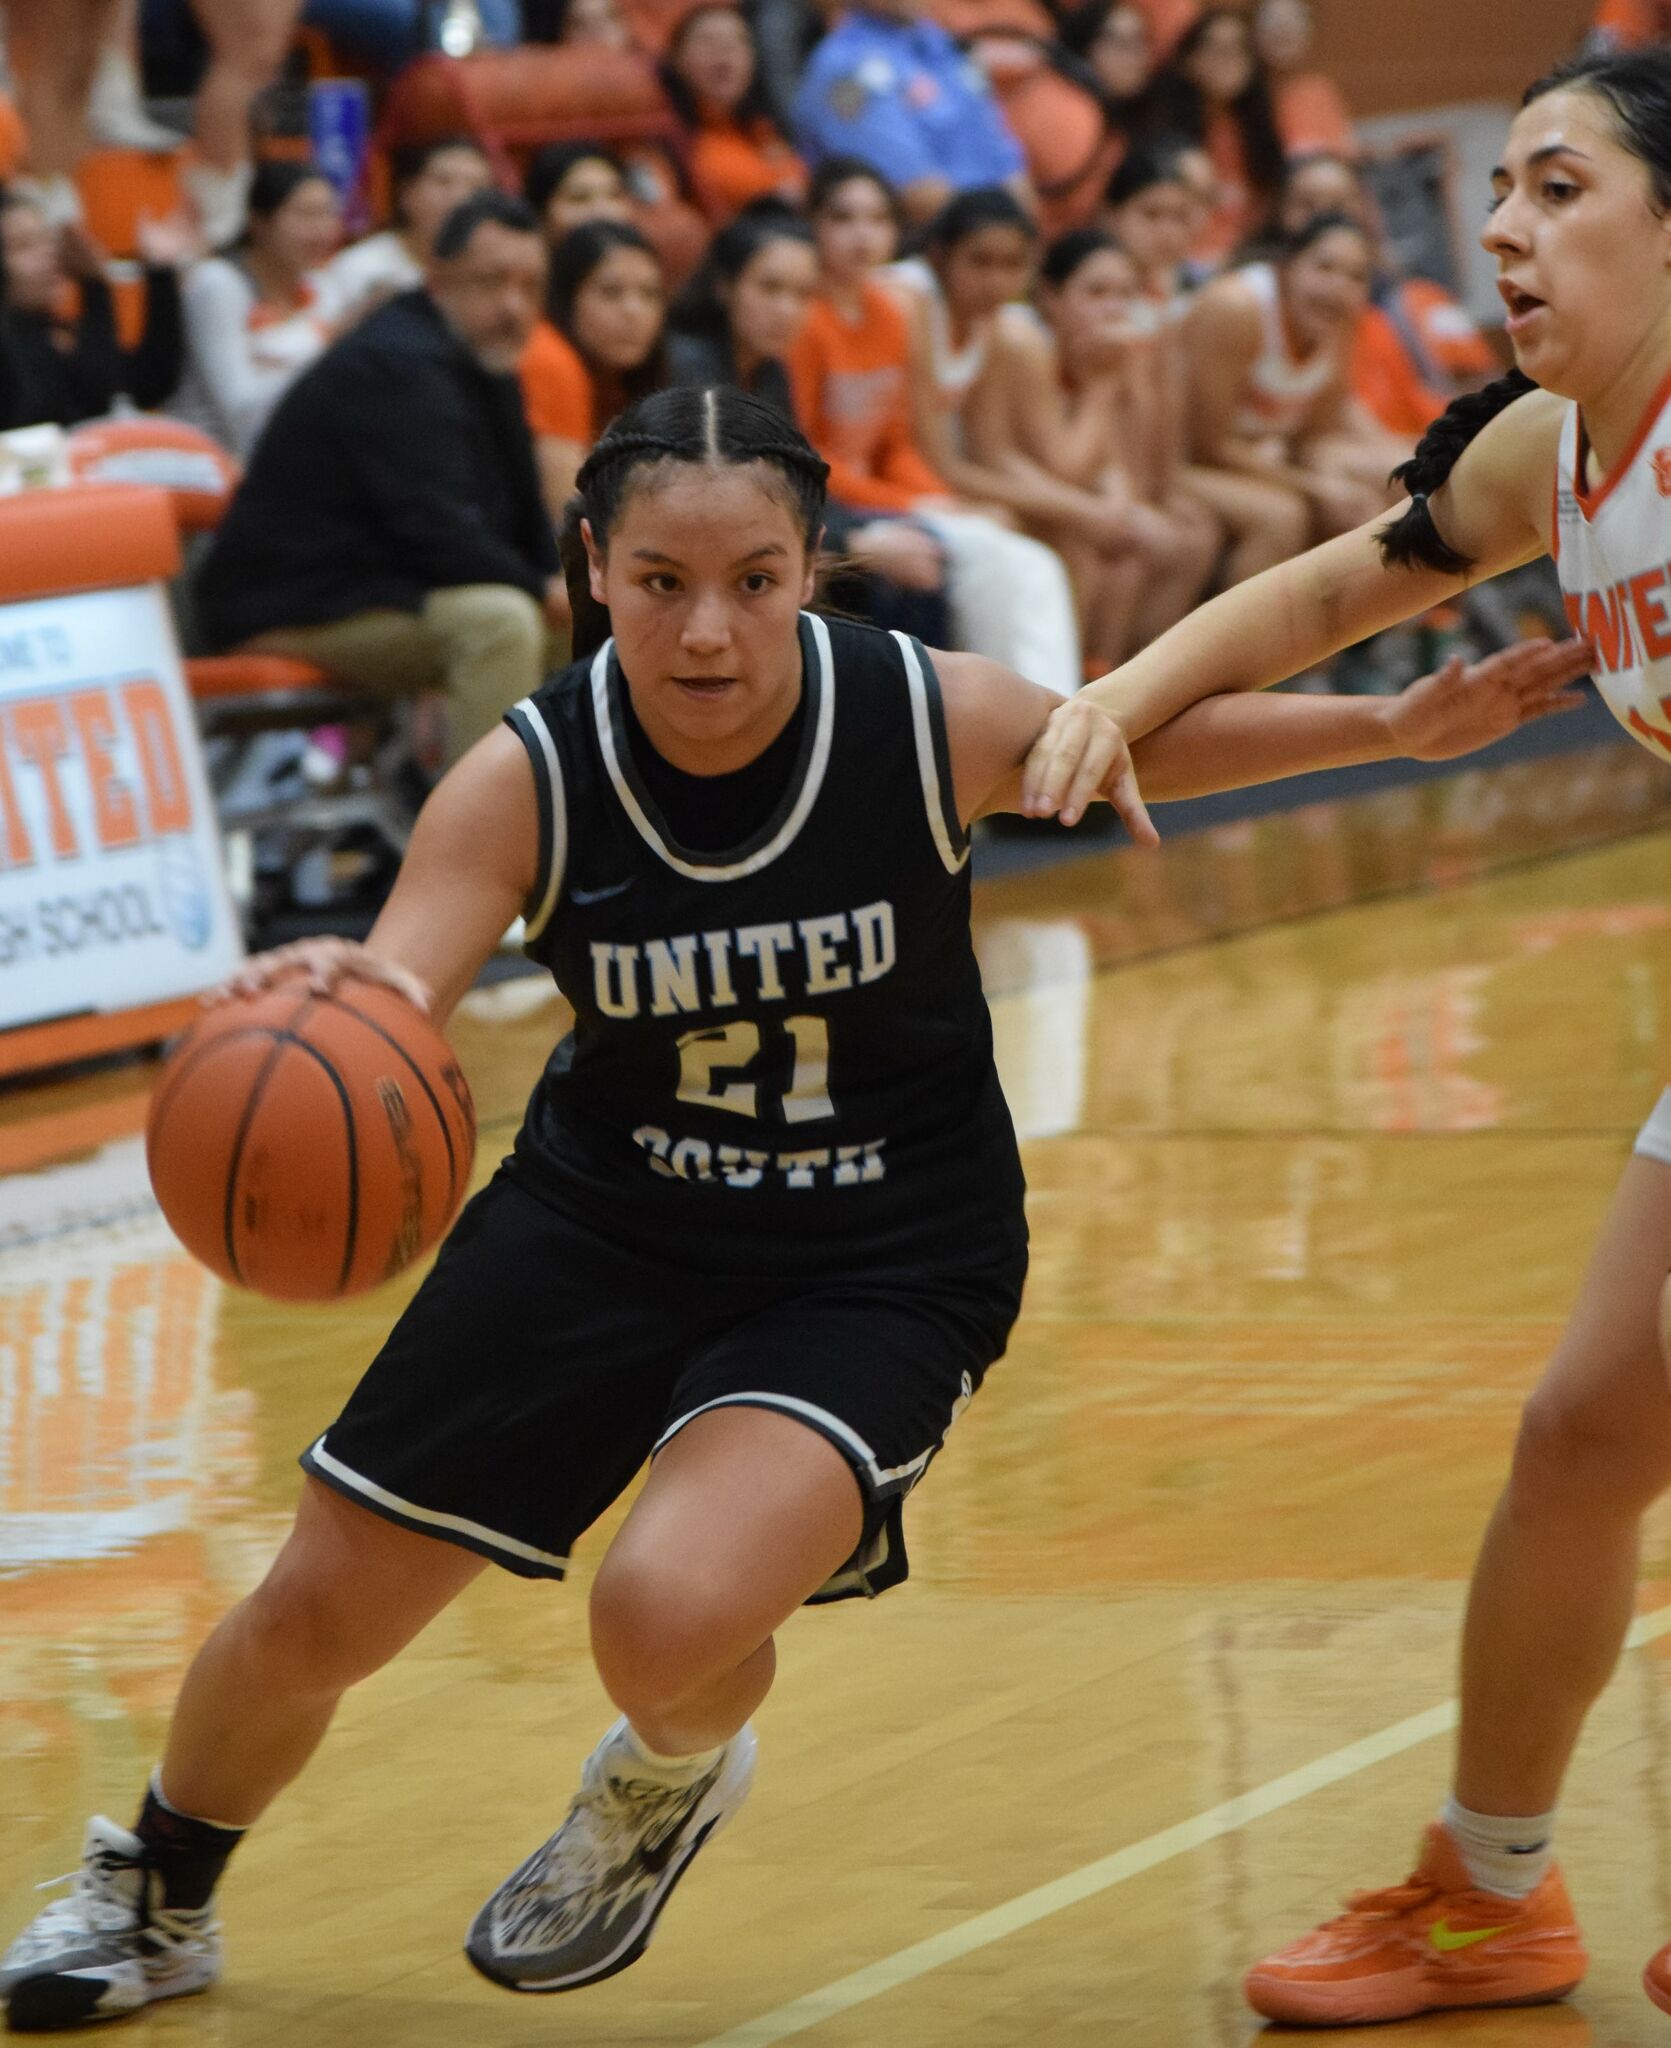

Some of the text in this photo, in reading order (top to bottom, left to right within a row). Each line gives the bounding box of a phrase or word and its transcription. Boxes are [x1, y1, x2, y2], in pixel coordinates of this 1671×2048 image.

[37, 882, 164, 955] SCHOOL
[590, 900, 897, 1018] UNITED
[675, 1015, 836, 1124] 21
